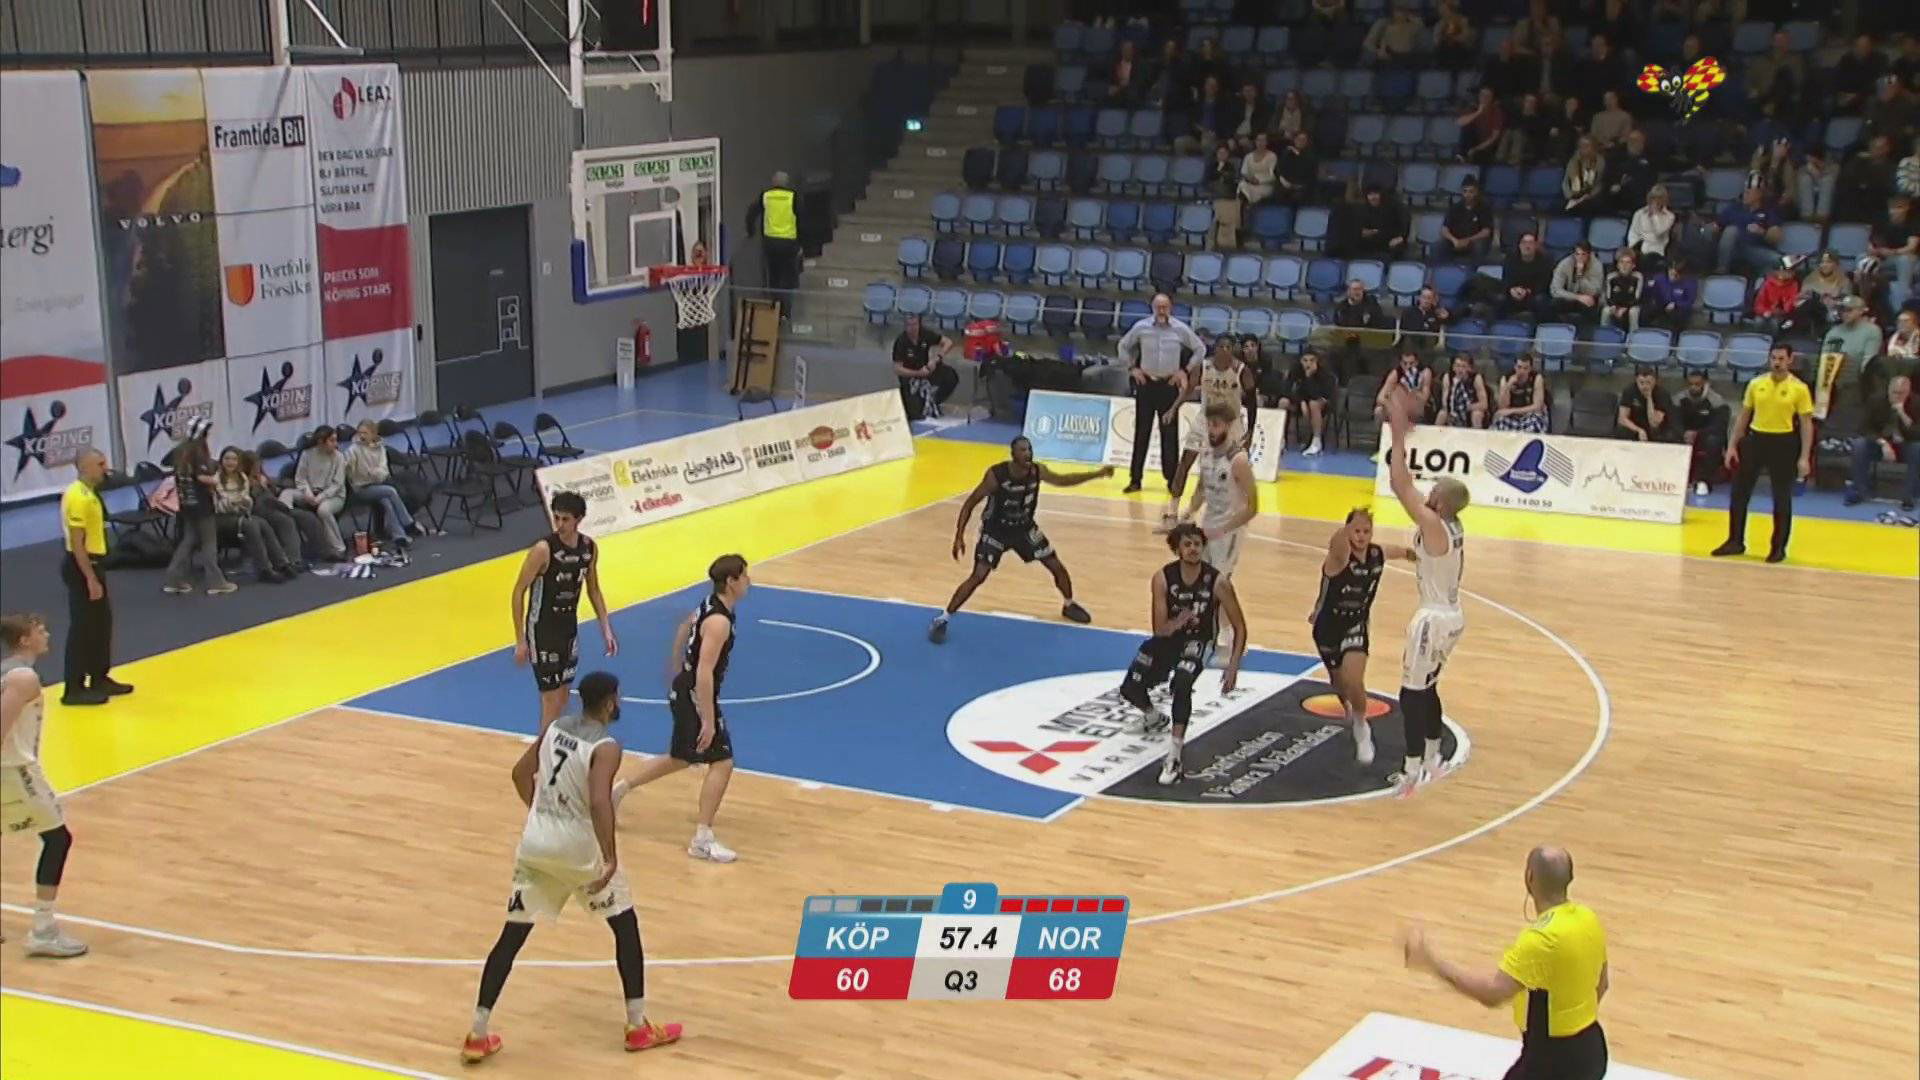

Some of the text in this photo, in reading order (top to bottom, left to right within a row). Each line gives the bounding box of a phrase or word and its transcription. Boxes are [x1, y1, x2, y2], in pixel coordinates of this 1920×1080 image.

[214, 118, 304, 149] Framtida Bil
[118, 212, 202, 232] VOLVO
[358, 266, 379, 279] SOM
[362, 282, 392, 298] STARS
[549, 747, 569, 786] 7
